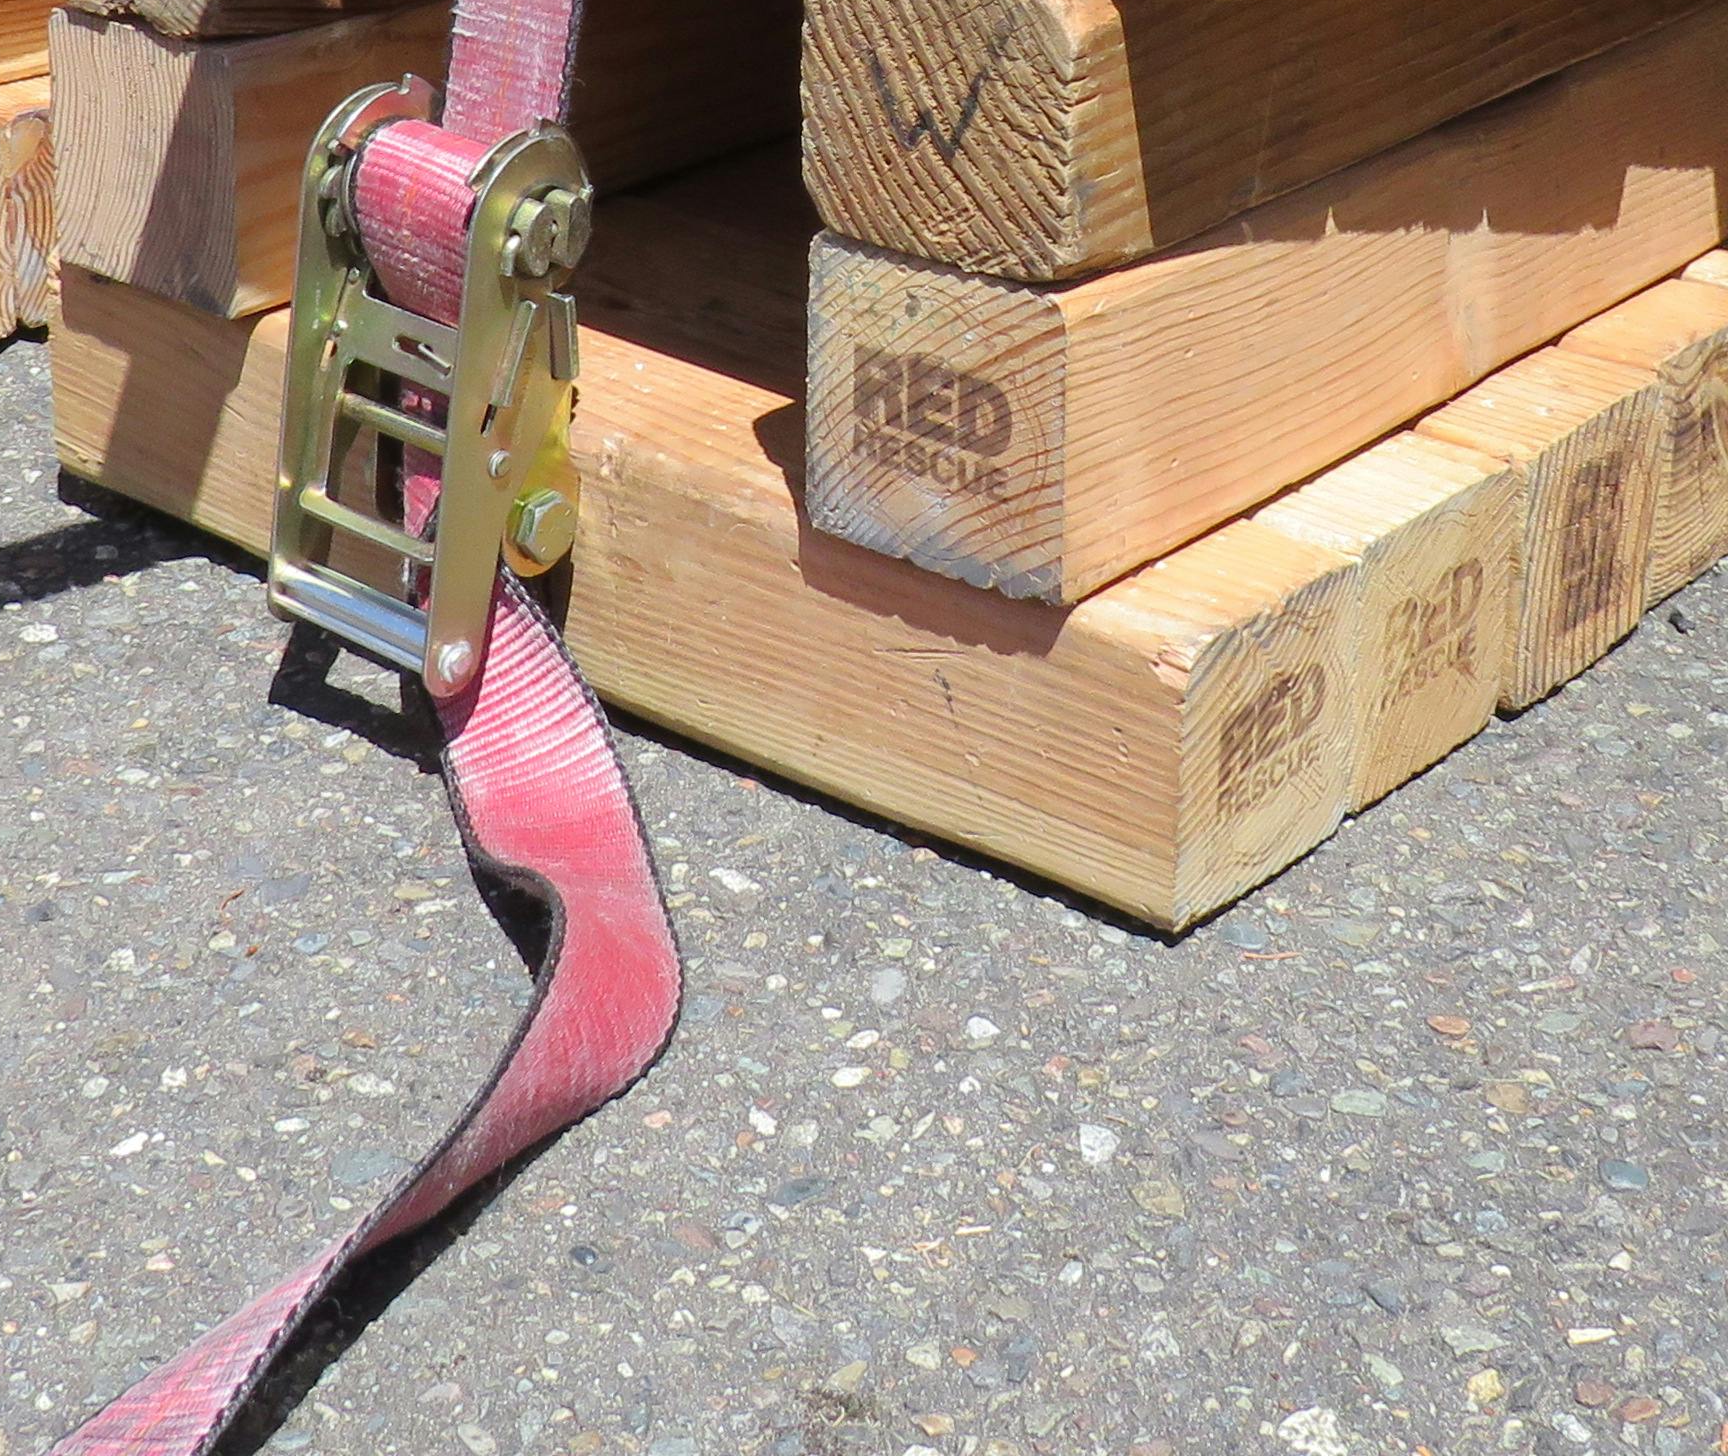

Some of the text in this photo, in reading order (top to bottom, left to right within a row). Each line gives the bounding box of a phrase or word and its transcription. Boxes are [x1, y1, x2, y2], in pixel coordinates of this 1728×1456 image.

[852, 342, 1013, 458] RED
[852, 422, 1010, 503] RESCUE
[1386, 557, 1485, 668] RED
[1219, 663, 1325, 774] RED
